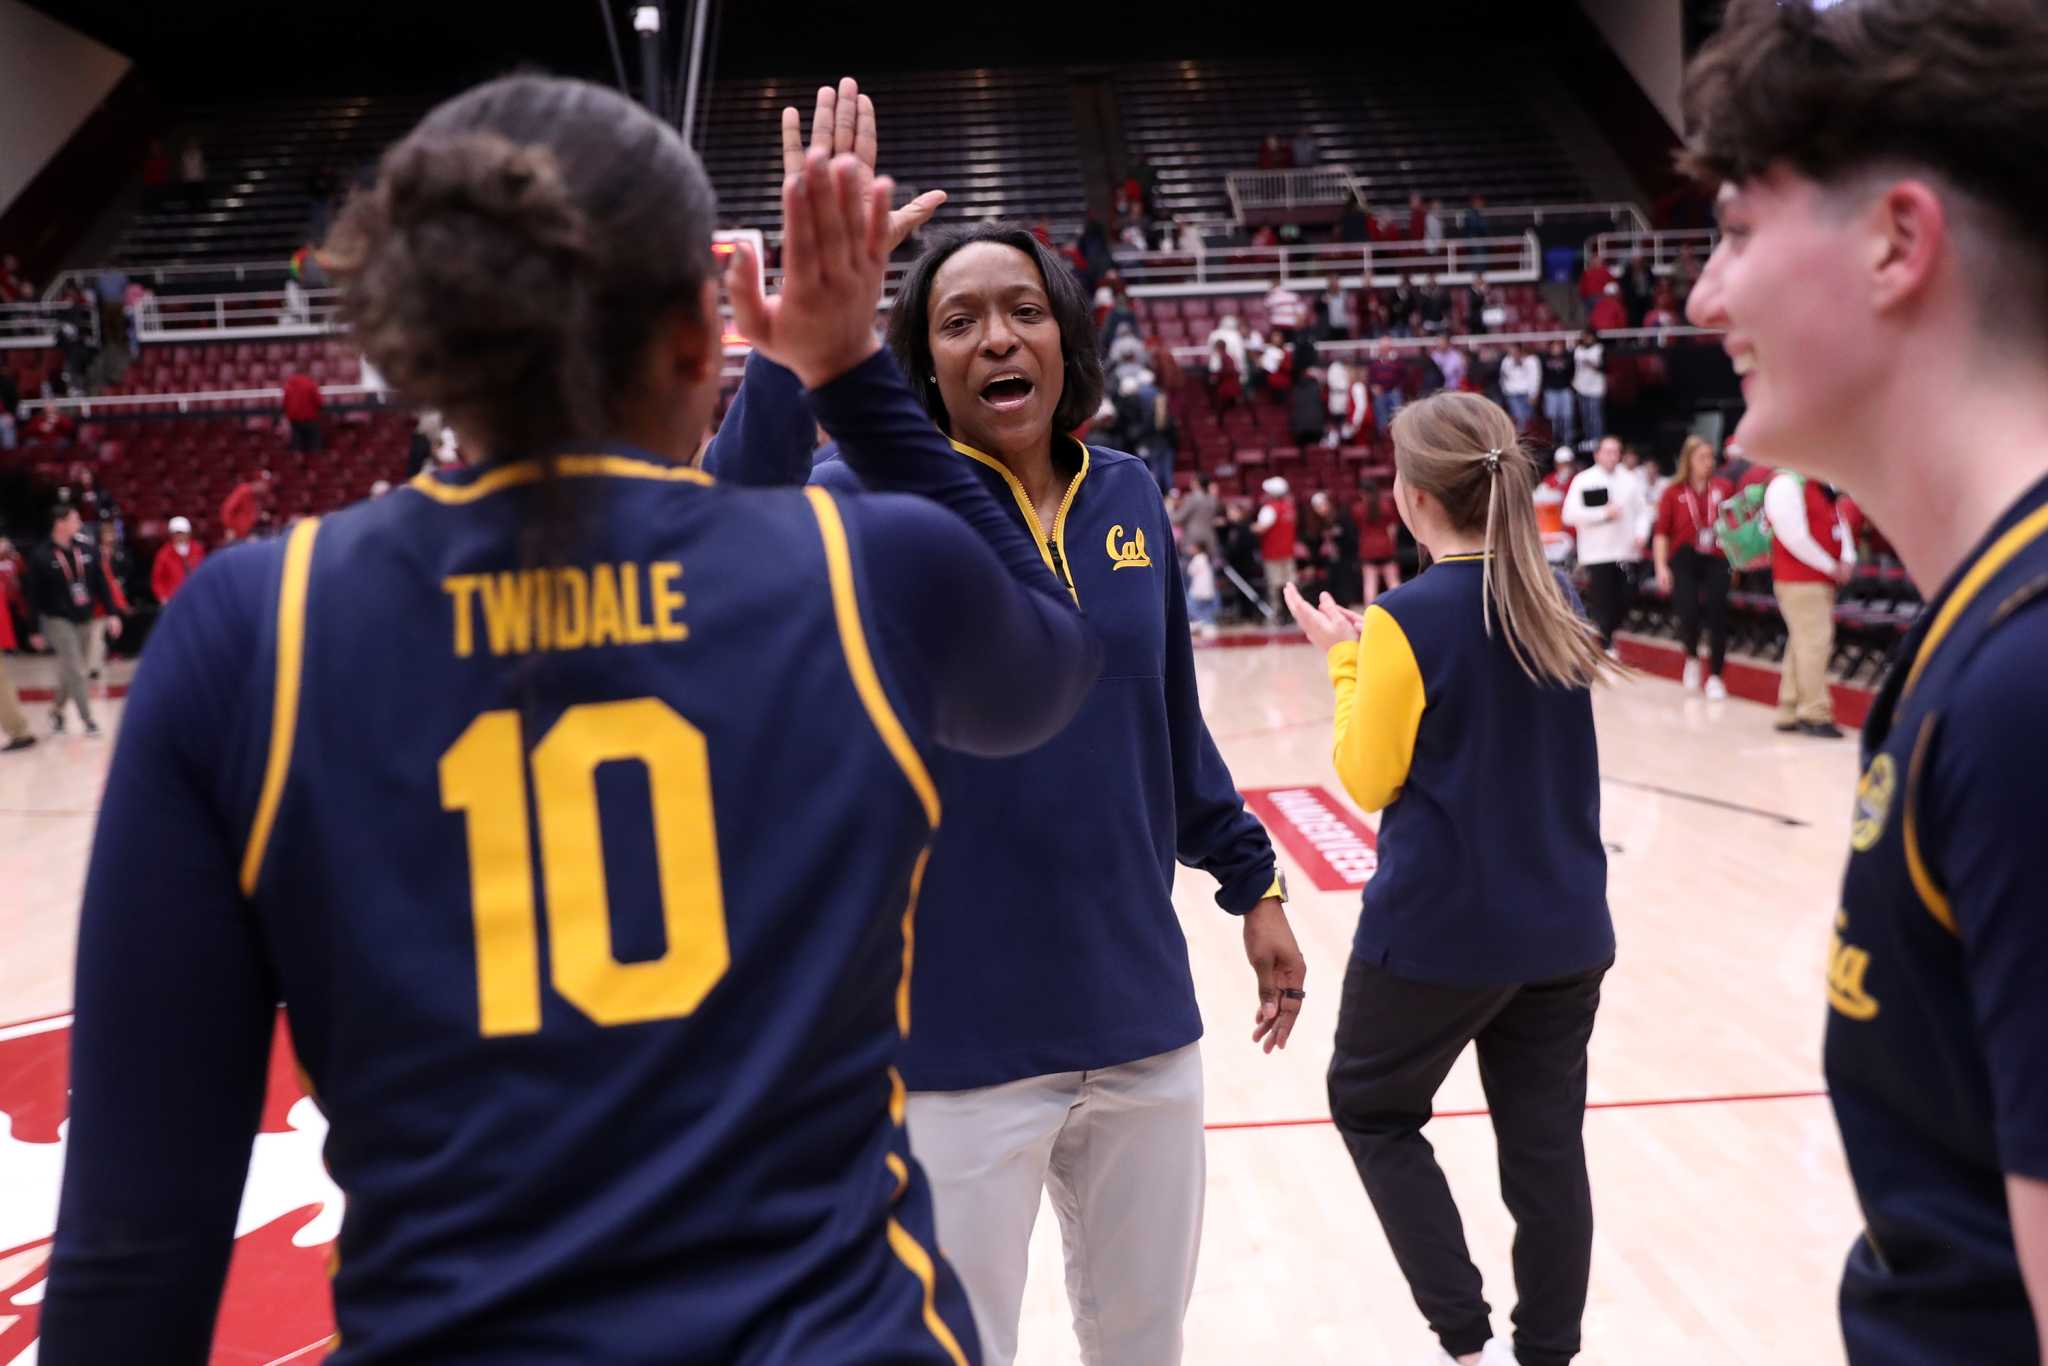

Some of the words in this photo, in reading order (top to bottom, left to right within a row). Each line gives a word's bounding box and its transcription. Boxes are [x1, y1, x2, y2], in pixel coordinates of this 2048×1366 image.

[1105, 524, 1152, 571] Cal
[442, 560, 689, 658] TWIDALE
[438, 696, 731, 1037] 10
